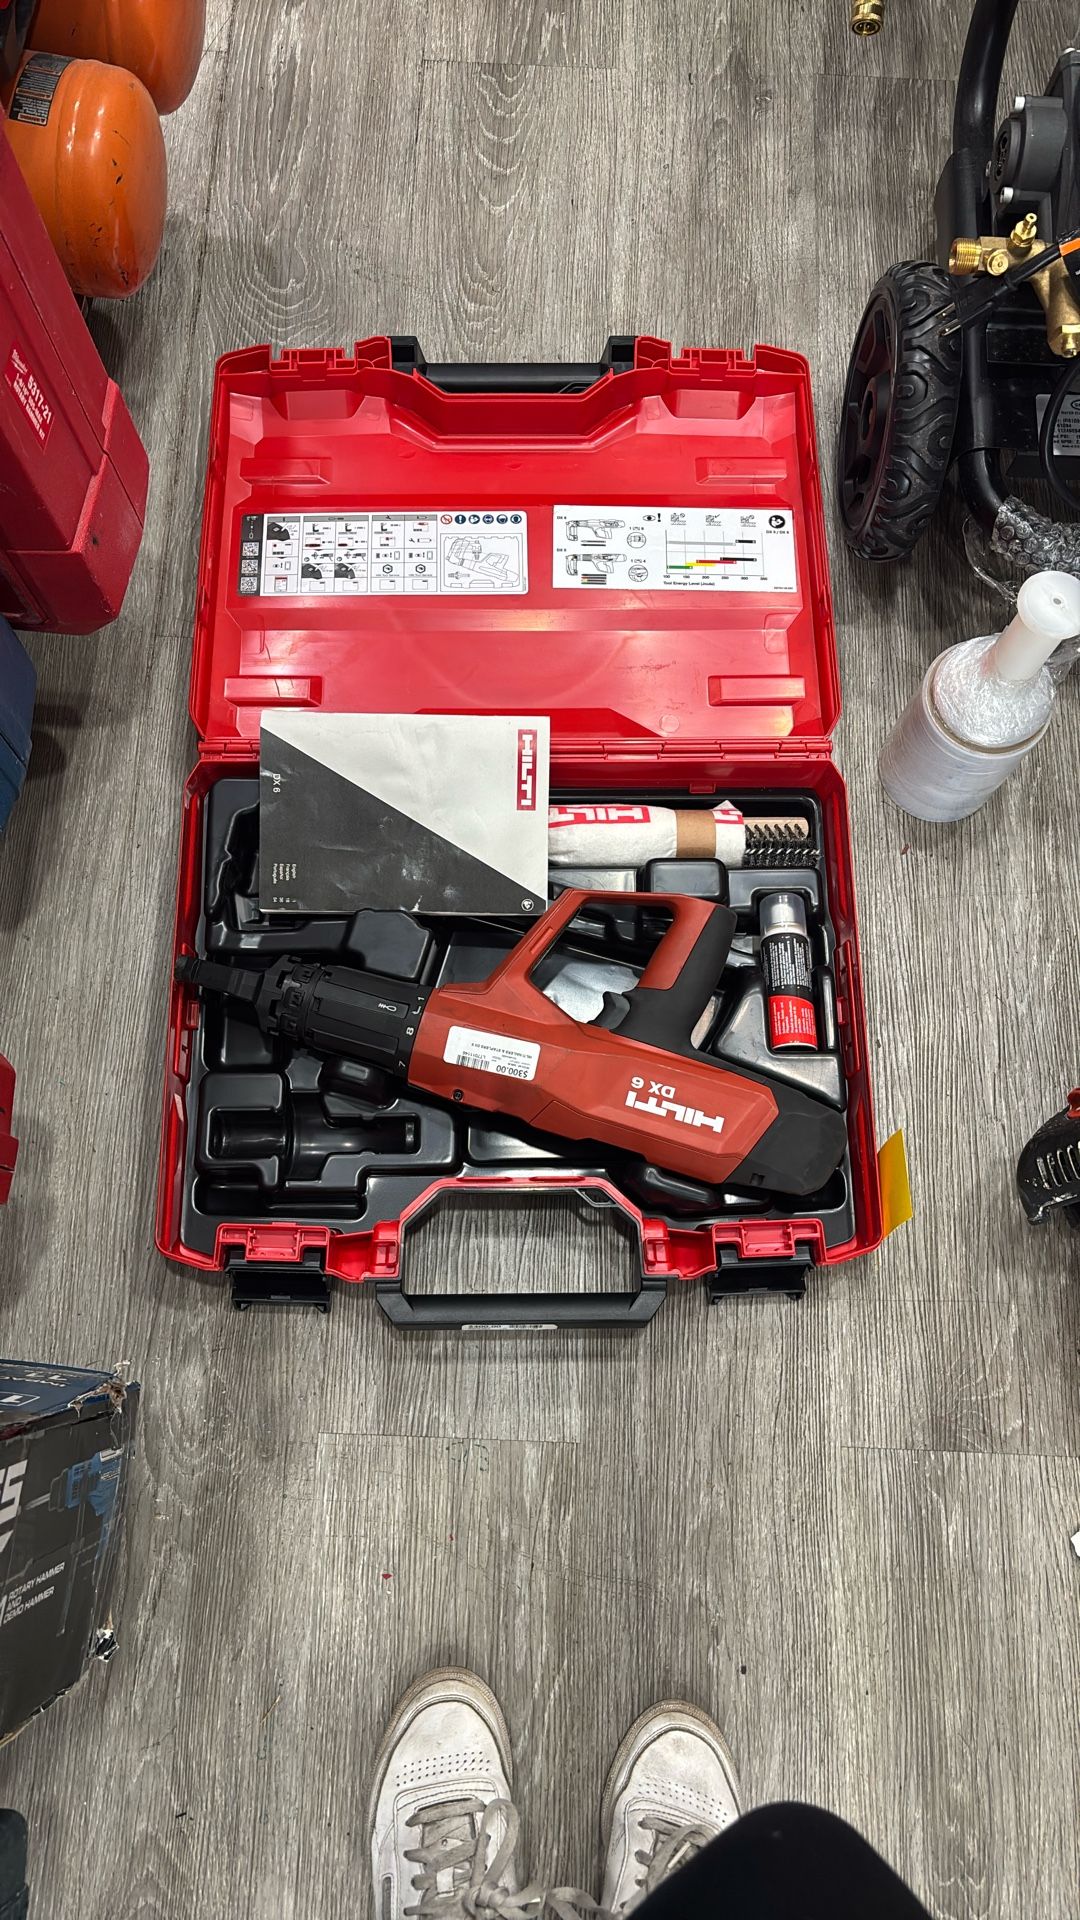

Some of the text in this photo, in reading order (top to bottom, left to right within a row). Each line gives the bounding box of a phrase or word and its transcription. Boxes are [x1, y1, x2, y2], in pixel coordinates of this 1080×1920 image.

[28, 374, 52, 424] 5317-21
[519, 731, 534, 808] HILTI
[273, 774, 280, 786] DX
[549, 806, 643, 823] HILT
[405, 1026, 415, 1036] 8
[480, 1044, 501, 1053] STAPLERS
[496, 1064, 529, 1079] $300.00
[630, 1076, 676, 1099] DX 6
[624, 1090, 725, 1134] HILTI
[8, 1561, 65, 1602] ROTARY HAMMER
[3, 1603, 24, 1625] DEMO
[24, 1585, 55, 1611] HAMMER
[6, 1595, 22, 1612] AND
